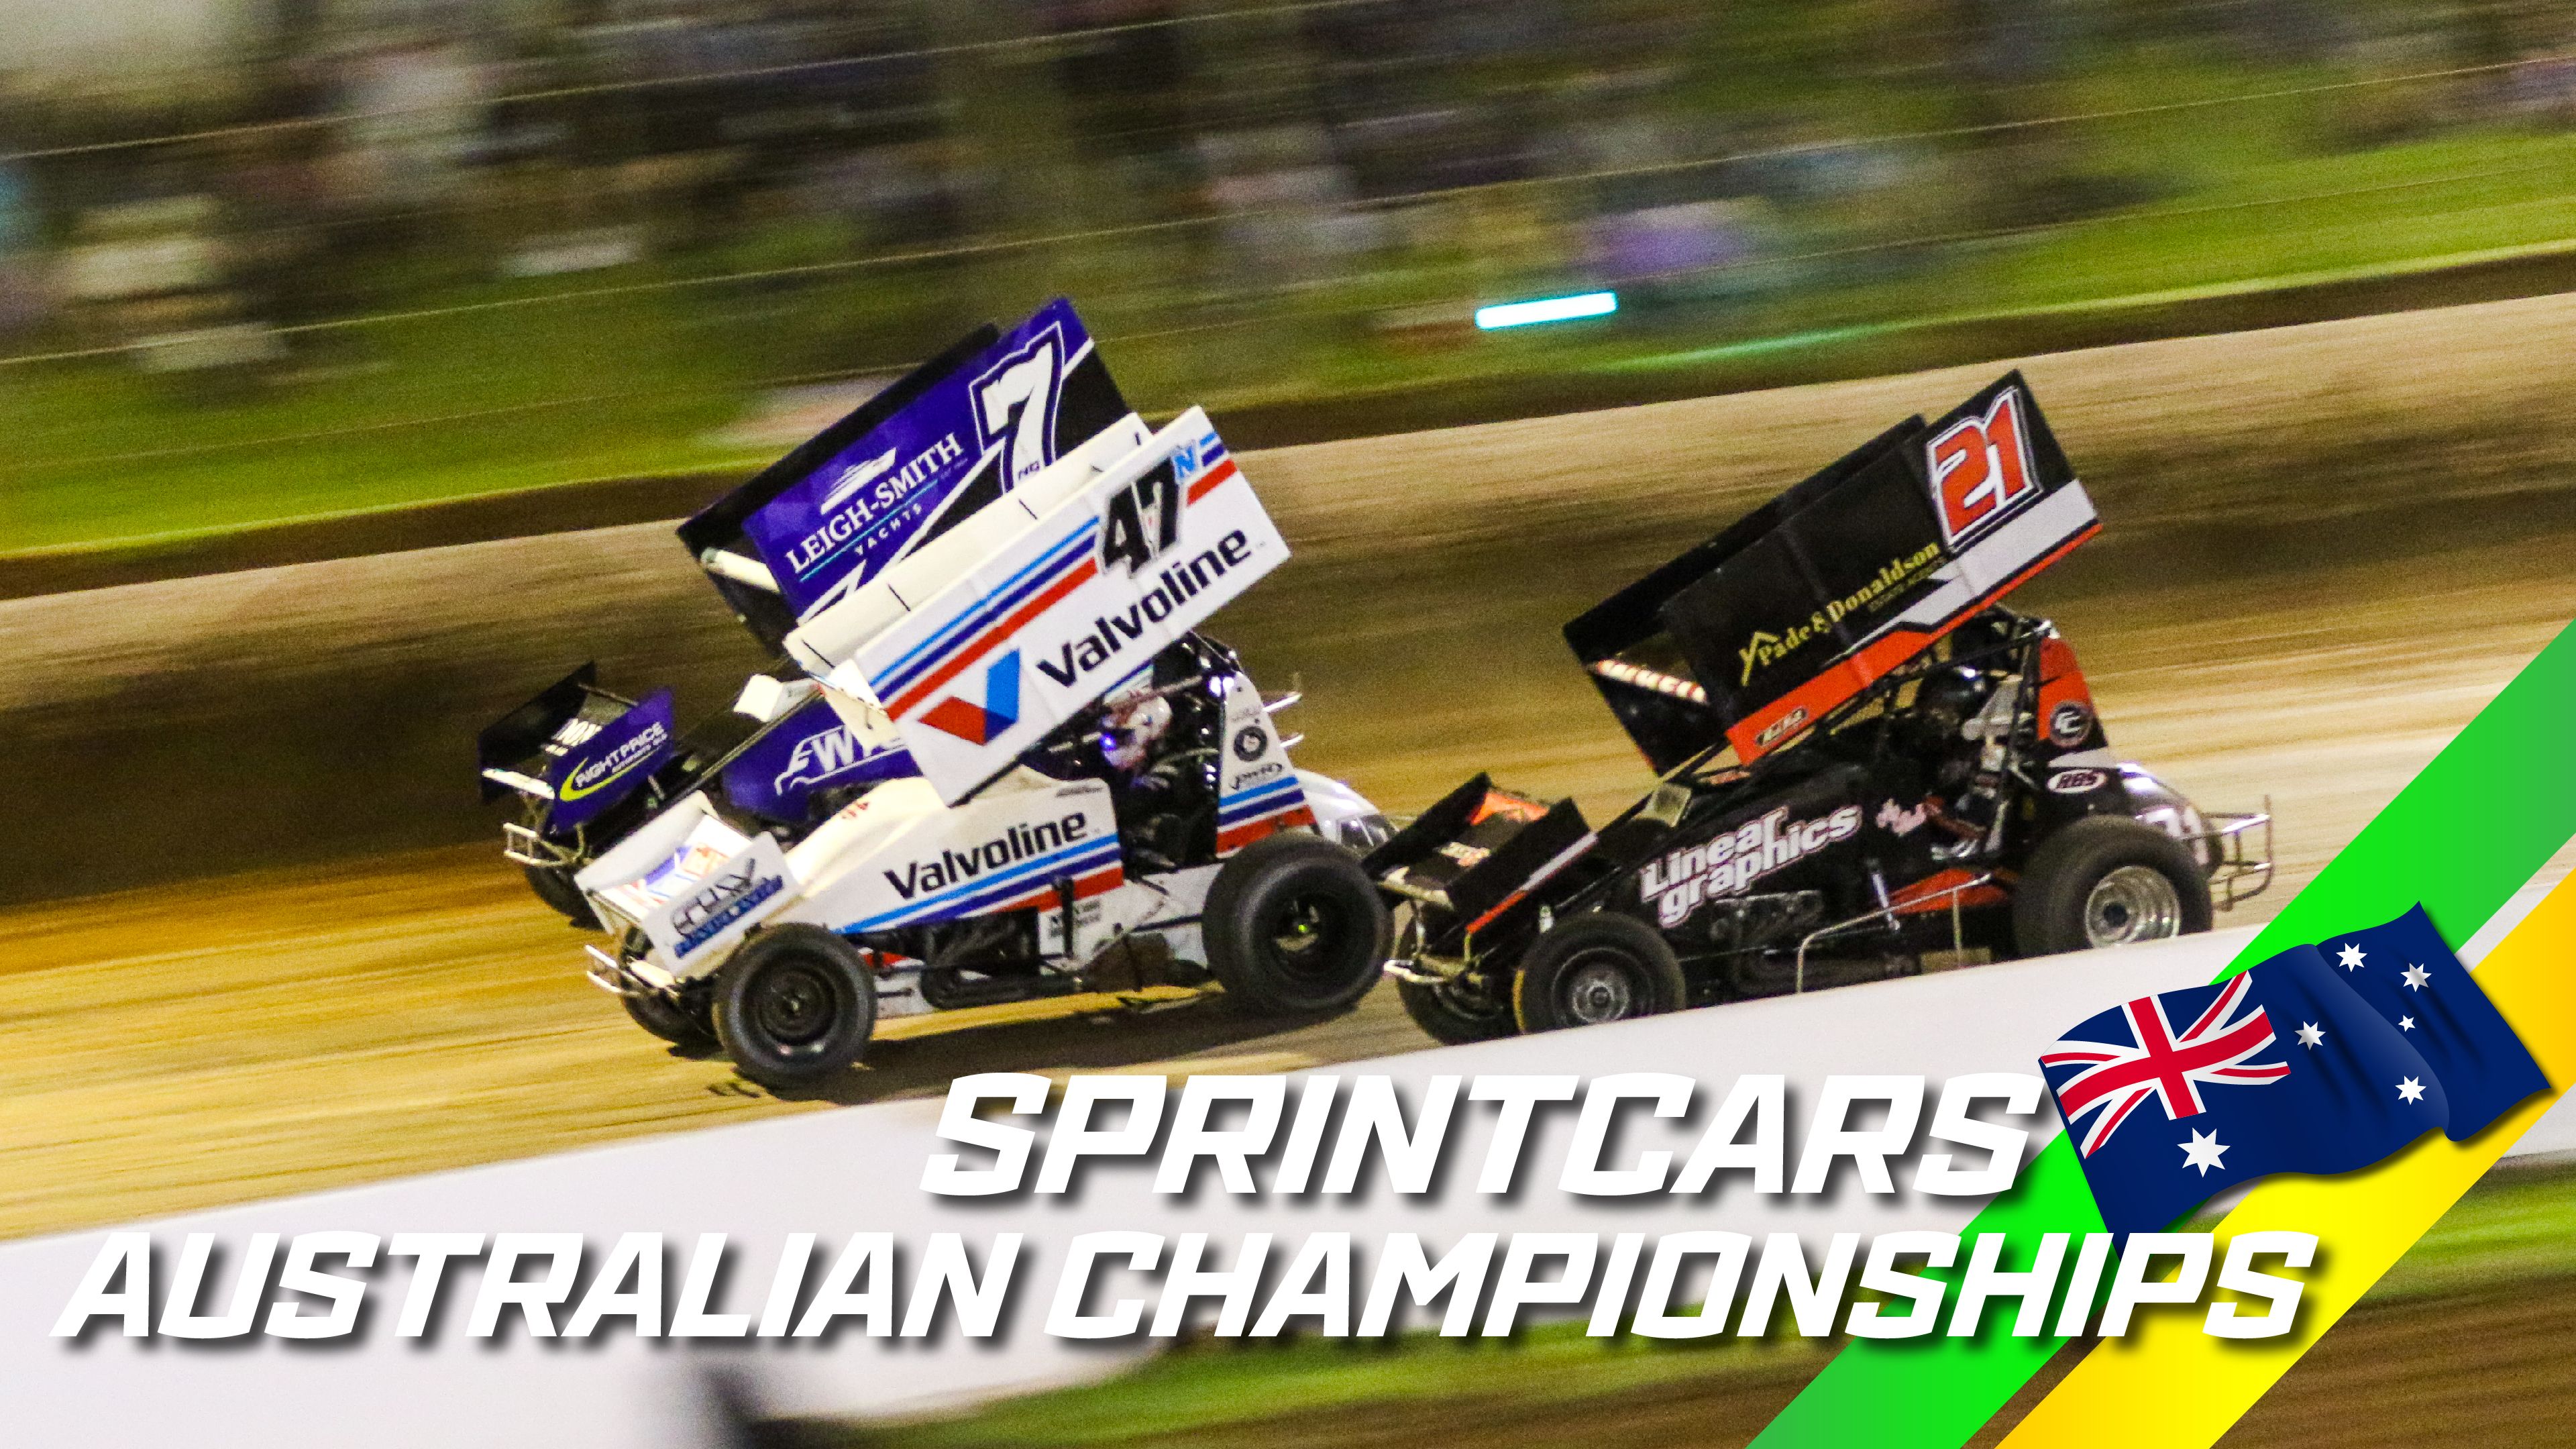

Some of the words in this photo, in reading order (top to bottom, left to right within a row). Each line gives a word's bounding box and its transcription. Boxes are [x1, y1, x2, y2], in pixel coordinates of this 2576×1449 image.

[975, 330, 1059, 492] 7
[1931, 393, 2035, 542] 21
[785, 431, 965, 574] LEIGH-SMITH
[853, 502, 923, 556] YACHTS
[1103, 455, 1179, 574] 47
[1035, 527, 1252, 688] Valvoline
[1825, 541, 1941, 623] Donaldson
[883, 811, 1087, 899] Valvoline
[1641, 807, 1787, 902] Linear
[1658, 806, 1861, 927] graphics
